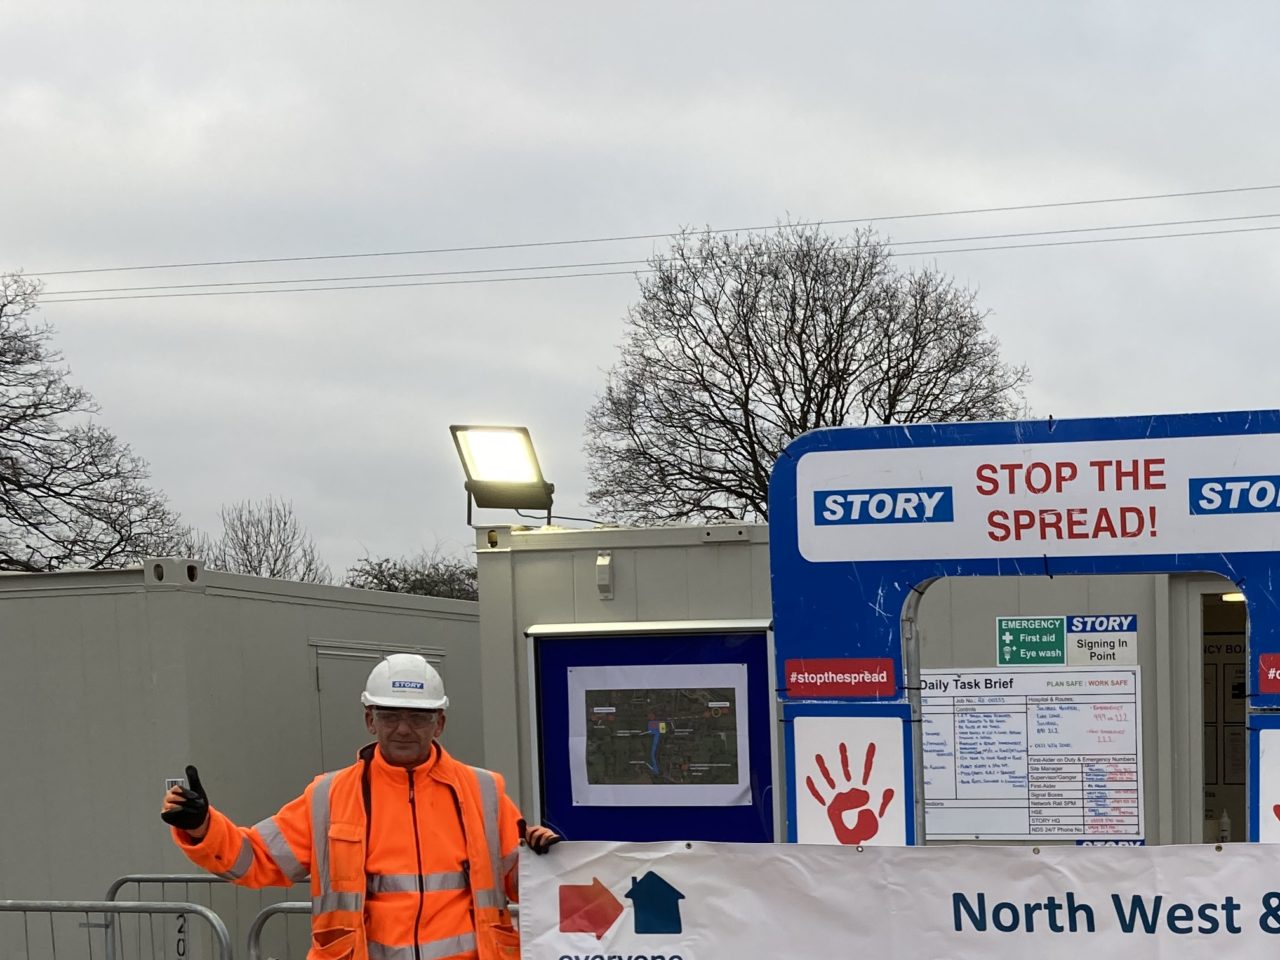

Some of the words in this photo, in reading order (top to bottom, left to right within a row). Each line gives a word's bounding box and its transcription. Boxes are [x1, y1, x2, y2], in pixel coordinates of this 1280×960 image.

[975, 462, 1078, 496] STOP
[1090, 458, 1167, 491] THE
[822, 491, 944, 522] STORY
[986, 505, 1159, 543] SPREAD!
[1002, 620, 1061, 629] EMERGENCY
[1071, 616, 1133, 632] STORY
[1020, 633, 1040, 642] First
[1042, 633, 1056, 642] aid
[1076, 639, 1116, 651] Signing
[1118, 639, 1128, 648] In
[1020, 649, 1037, 659] Eye
[1039, 648, 1062, 658] wash
[1089, 651, 1116, 661] Point
[394, 681, 422, 689] STORY
[790, 671, 887, 686] #stopthespread
[920, 679, 949, 693] Daily
[953, 678, 981, 690] Task
[984, 678, 1014, 689] Brief
[952, 891, 1096, 933] North
[1110, 893, 1242, 935] West
